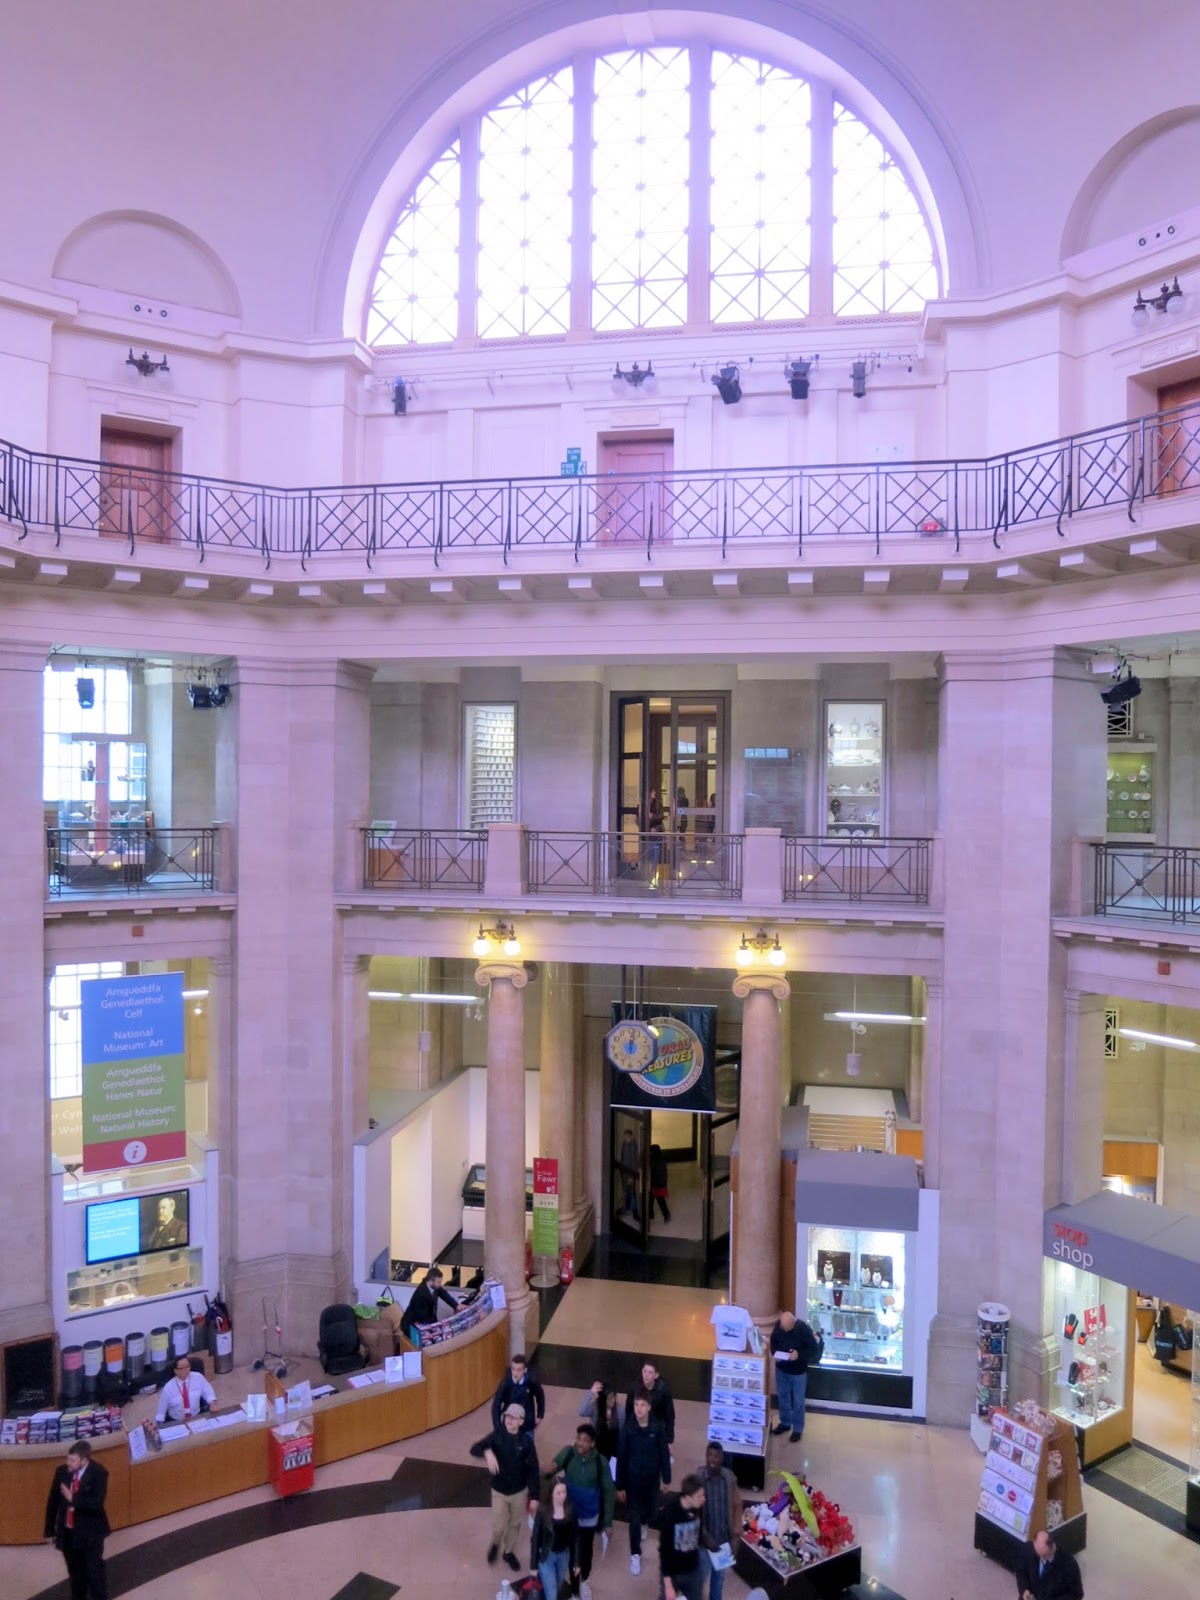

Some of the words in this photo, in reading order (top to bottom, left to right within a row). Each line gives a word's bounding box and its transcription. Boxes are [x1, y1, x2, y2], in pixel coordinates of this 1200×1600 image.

[106, 984, 160, 997] Amgueddfa
[101, 995, 166, 1009] Genedlaethol:
[124, 1008, 143, 1018] Celf
[114, 1028, 154, 1040] National
[103, 1042, 146, 1053] Museum:
[149, 1039, 164, 1048] Art
[642, 1050, 693, 1074] EASURES
[107, 1063, 161, 1077] Amgueddfa
[102, 1075, 167, 1090] Genedlaethol:
[106, 1091, 134, 1101] Hanes
[137, 1087, 163, 1097] Natur
[92, 1109, 133, 1123] National
[135, 1105, 177, 1117] Museum:
[100, 1121, 135, 1134] Natural
[138, 1117, 170, 1129] History
[1053, 1239, 1094, 1269] shop
